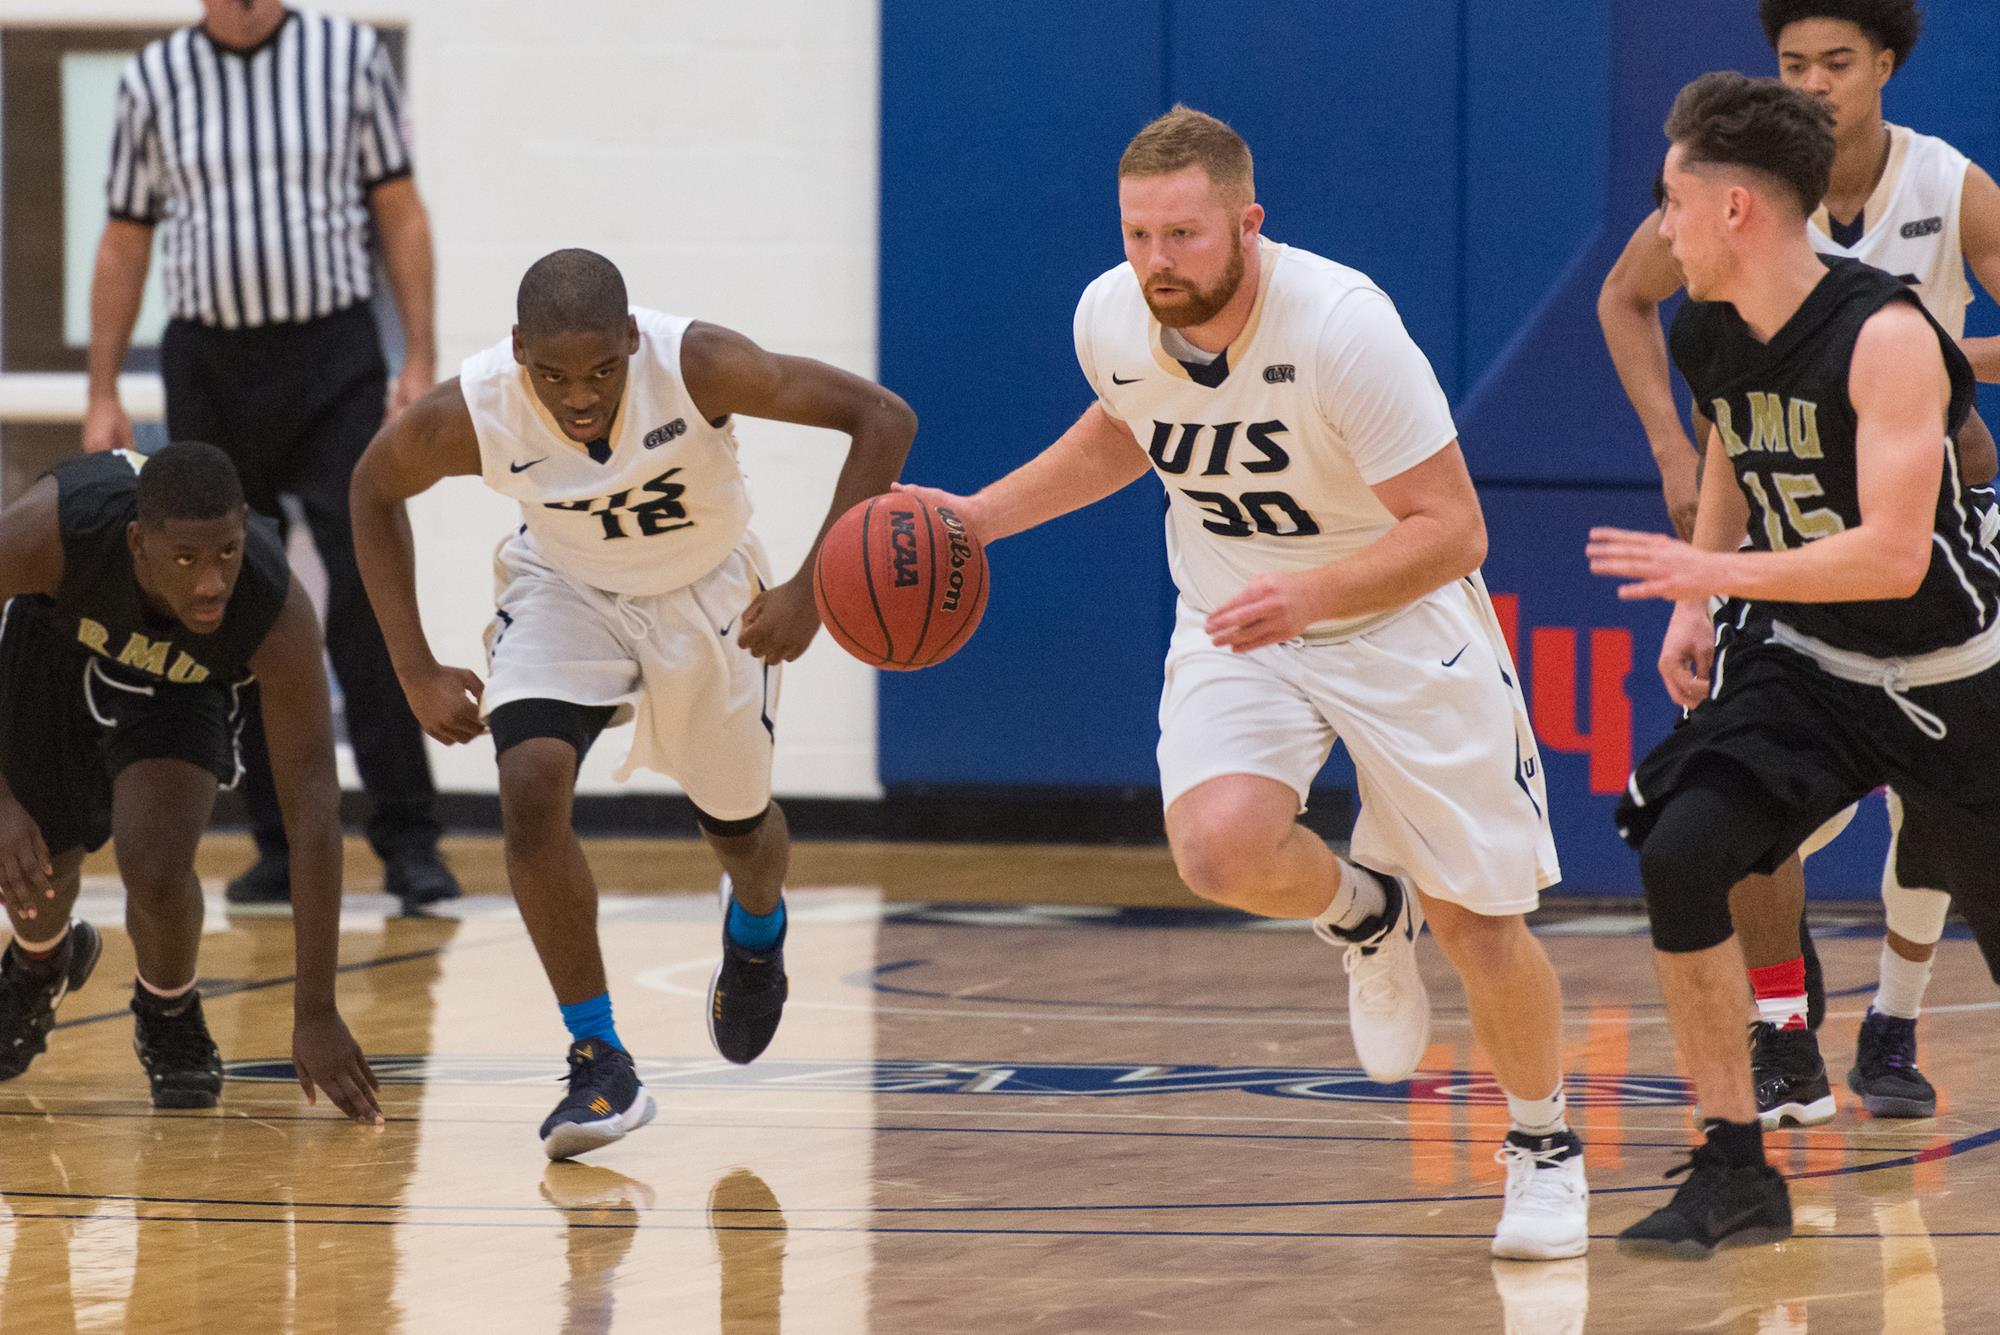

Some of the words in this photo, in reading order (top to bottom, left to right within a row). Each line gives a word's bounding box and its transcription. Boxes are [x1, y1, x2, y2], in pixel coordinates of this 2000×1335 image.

[1149, 419, 1289, 476] UIS
[543, 467, 686, 512] IS
[590, 500, 695, 540] 12
[1179, 488, 1320, 537] 30
[1743, 472, 1845, 552] 15
[890, 511, 919, 588] NCAA
[935, 506, 972, 612] Wilson
[78, 617, 210, 683] RMU
